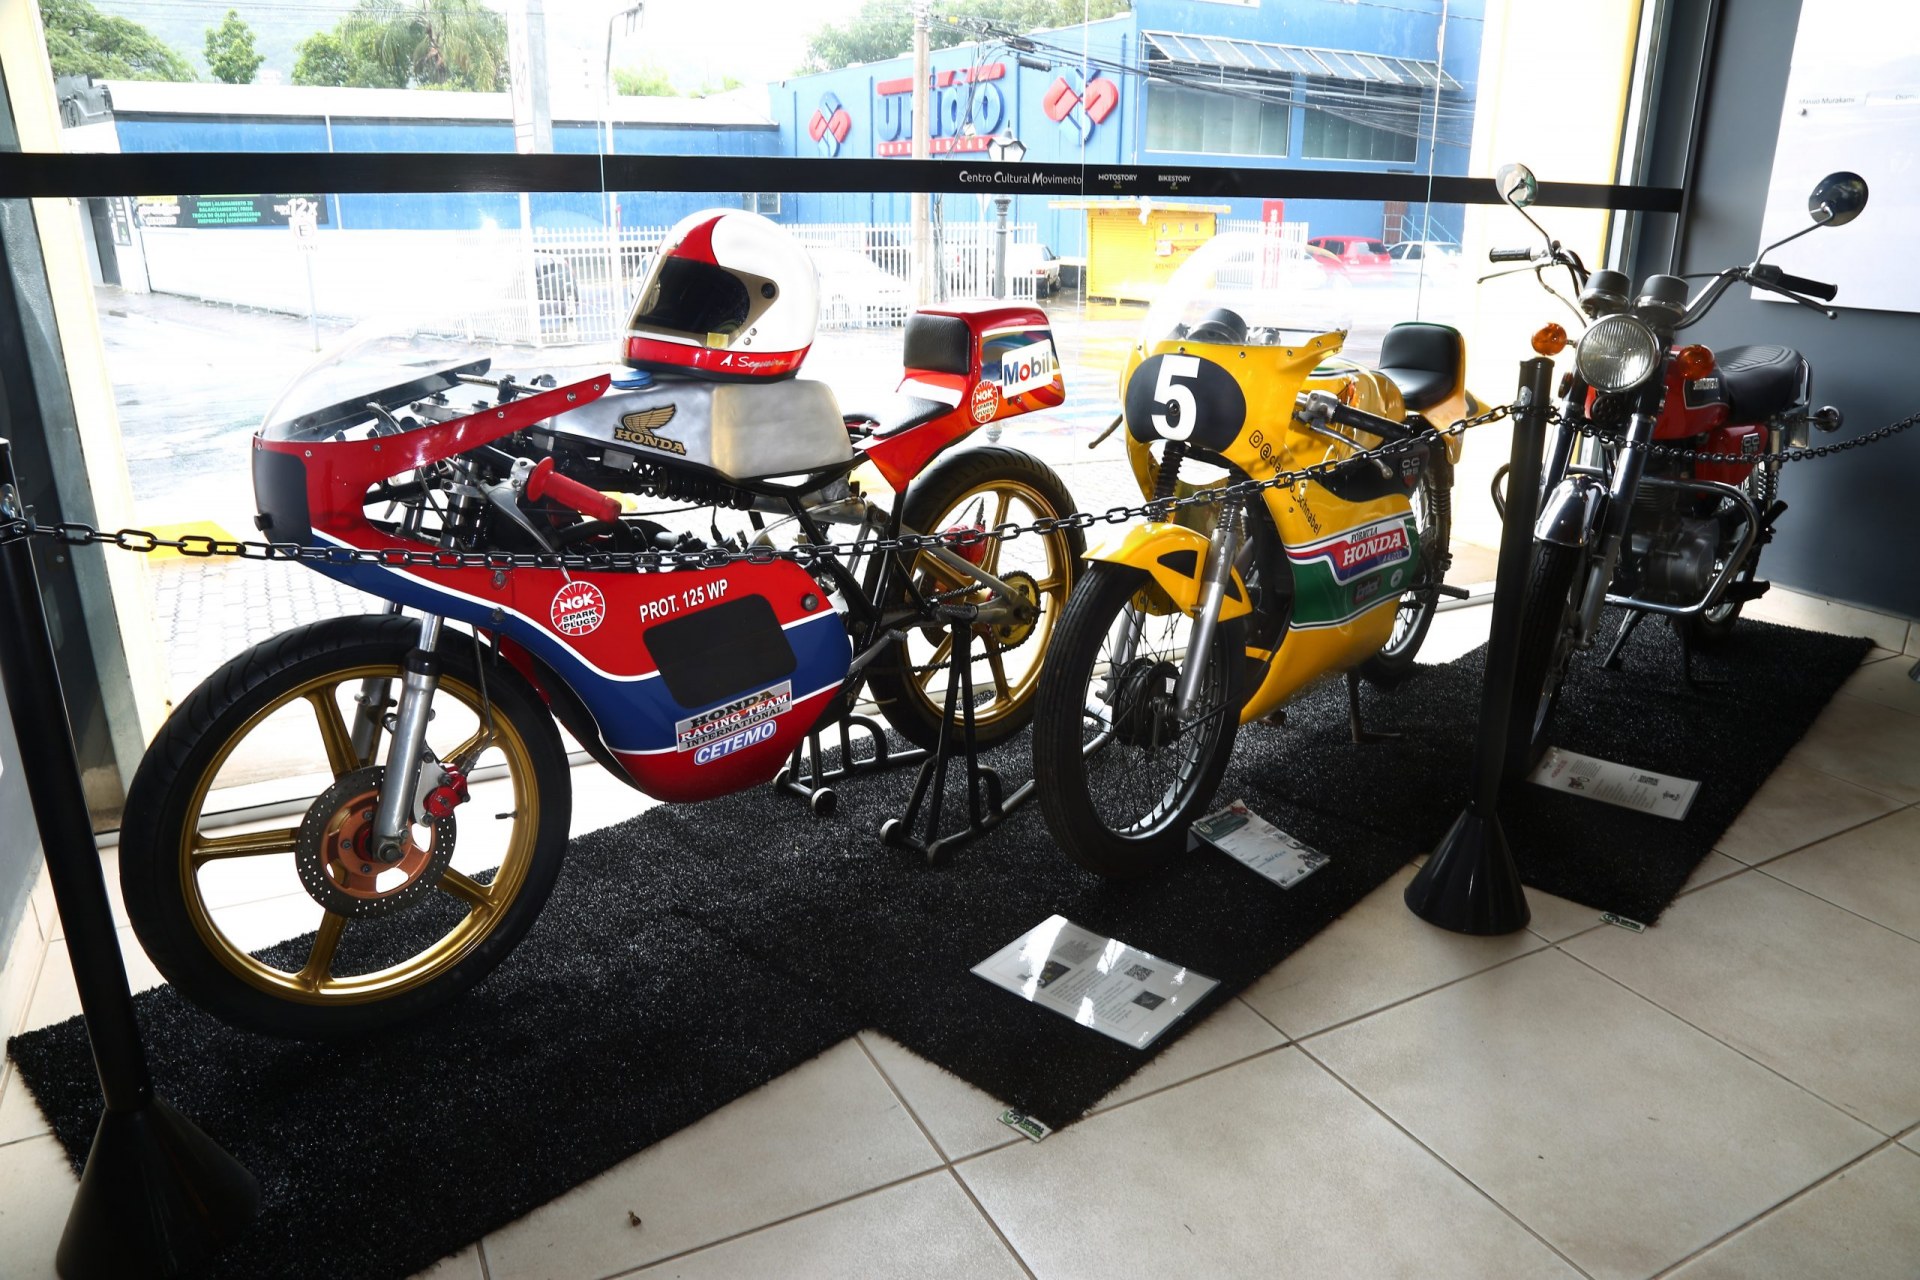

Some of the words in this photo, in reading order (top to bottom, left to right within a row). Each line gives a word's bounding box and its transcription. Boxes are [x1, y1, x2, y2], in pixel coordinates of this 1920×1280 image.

[959, 170, 992, 183] Centro
[994, 171, 1031, 184] Cultural
[1032, 172, 1082, 186] Movimento
[1098, 174, 1138, 182] MOTOSTORY
[1158, 175, 1191, 183] BIKESTORY
[1003, 351, 1049, 387] Mobil
[976, 387, 994, 403] NGK
[1150, 353, 1200, 441] 5
[614, 428, 687, 456] HONDA
[1343, 532, 1401, 567] HONDA
[559, 592, 595, 613] NGK
[562, 608, 596, 623] SPARK
[639, 595, 680, 623] PROT.
[683, 586, 705, 609] 125
[706, 579, 728, 600] WP
[563, 616, 597, 631] PLUGS
[680, 713, 741, 742] RACING
[746, 693, 788, 717] TEAM
[691, 691, 775, 728] HONDA
[686, 706, 784, 748] INTERNATIONAL
[697, 722, 774, 763] CETEMO
